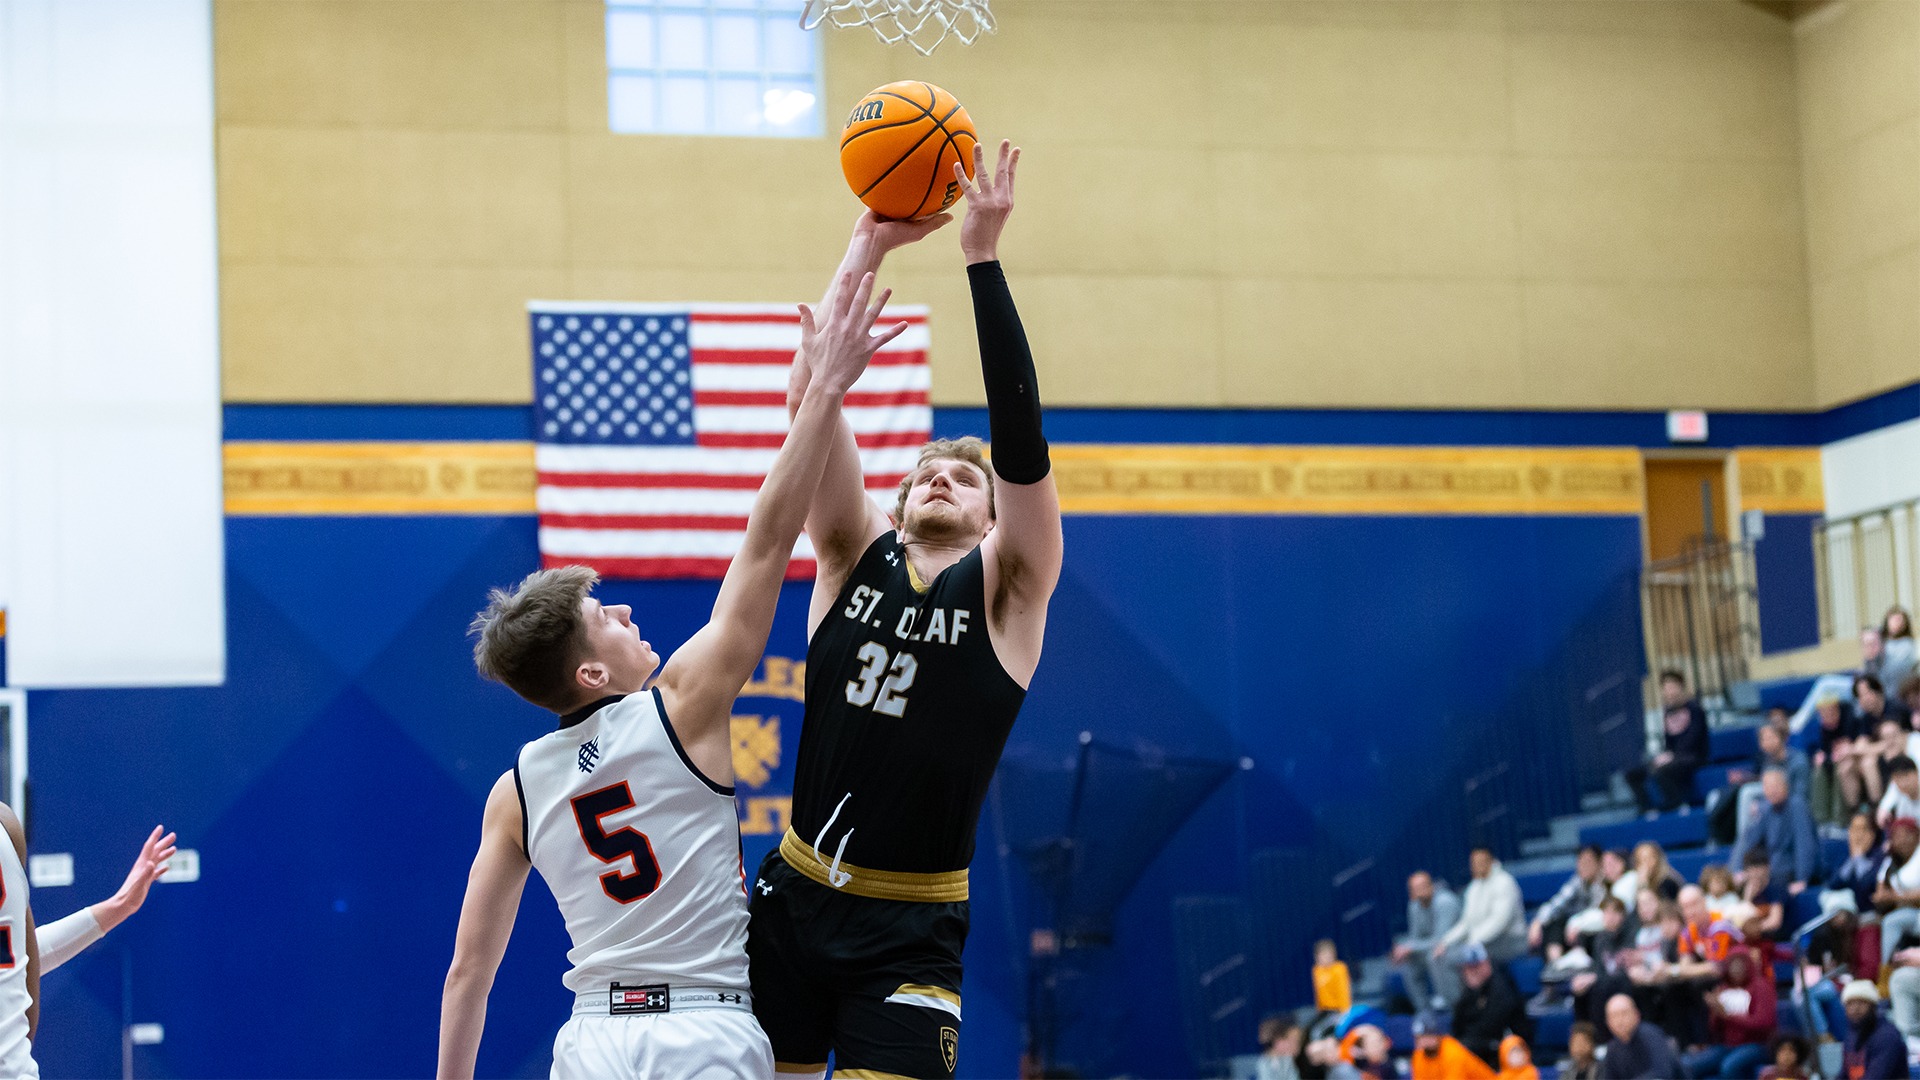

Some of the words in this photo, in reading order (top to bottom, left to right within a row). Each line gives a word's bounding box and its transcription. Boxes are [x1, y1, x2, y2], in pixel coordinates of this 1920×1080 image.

[844, 584, 885, 629] ST.
[845, 640, 919, 719] 32
[570, 779, 663, 905] 5
